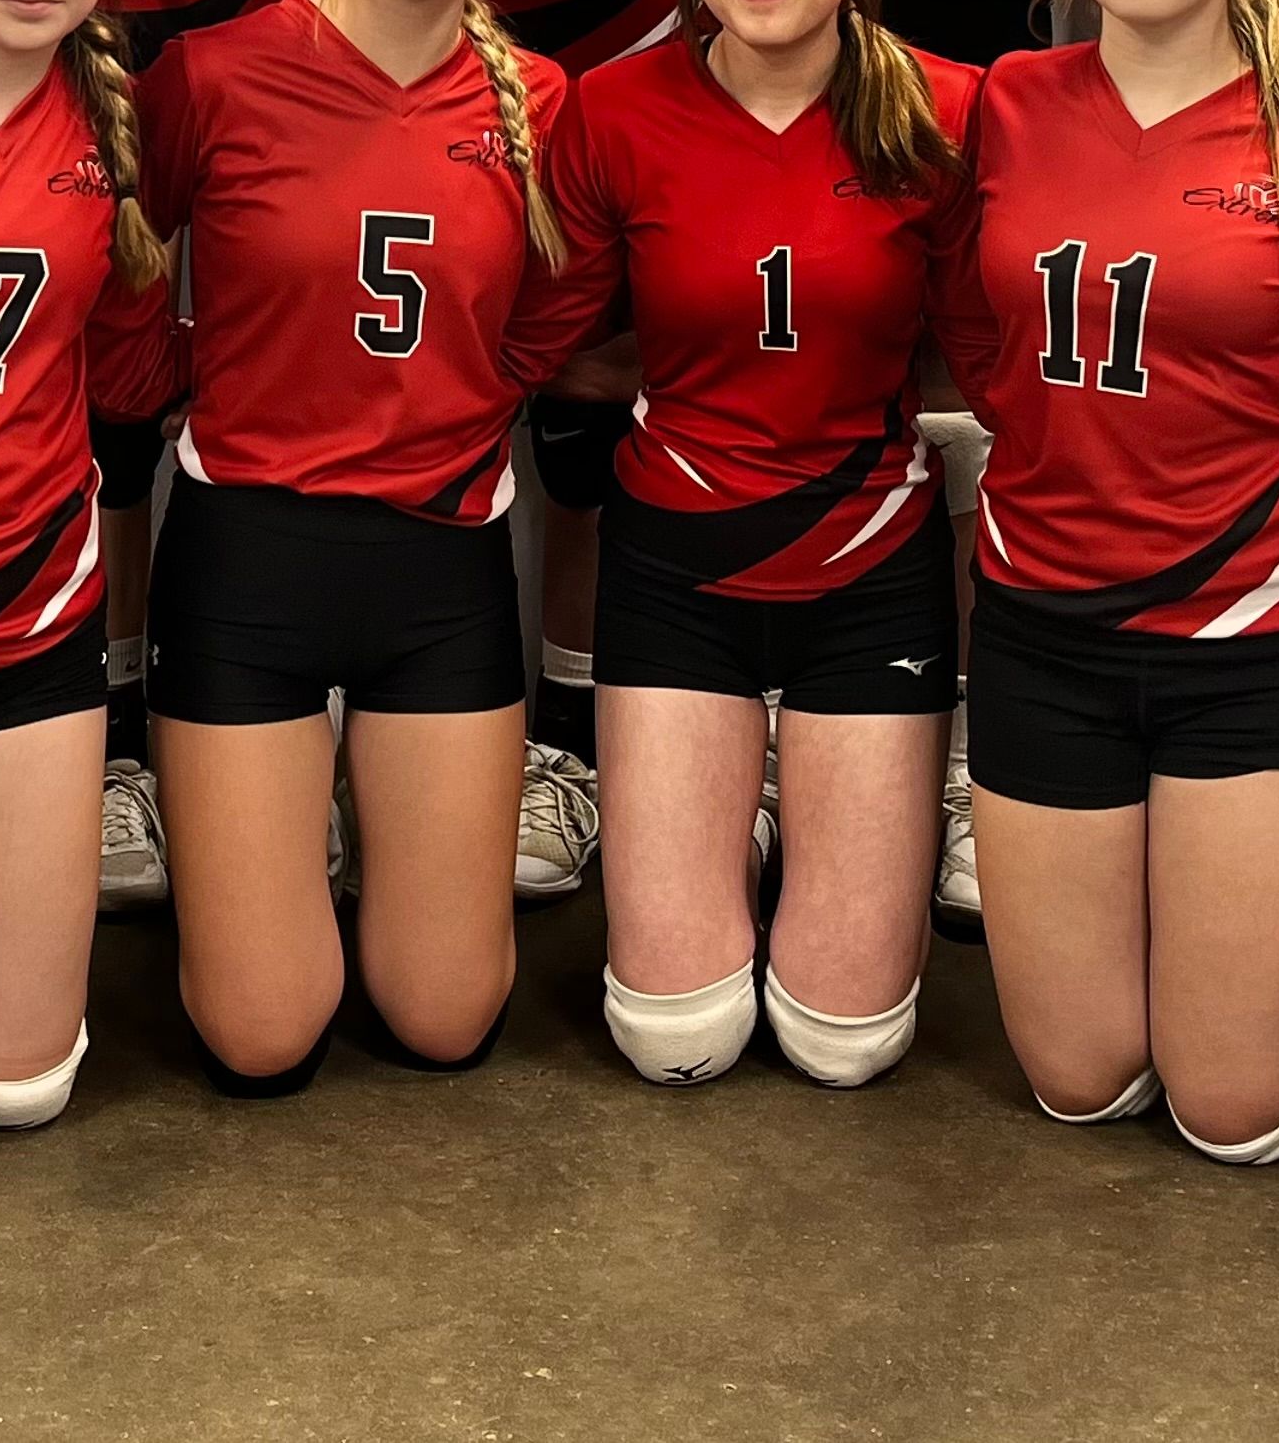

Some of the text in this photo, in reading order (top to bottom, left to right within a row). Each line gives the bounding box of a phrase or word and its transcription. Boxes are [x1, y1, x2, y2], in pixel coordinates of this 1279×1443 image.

[354, 210, 437, 359] 5
[756, 245, 799, 353] 1
[1033, 238, 1159, 400] 11
